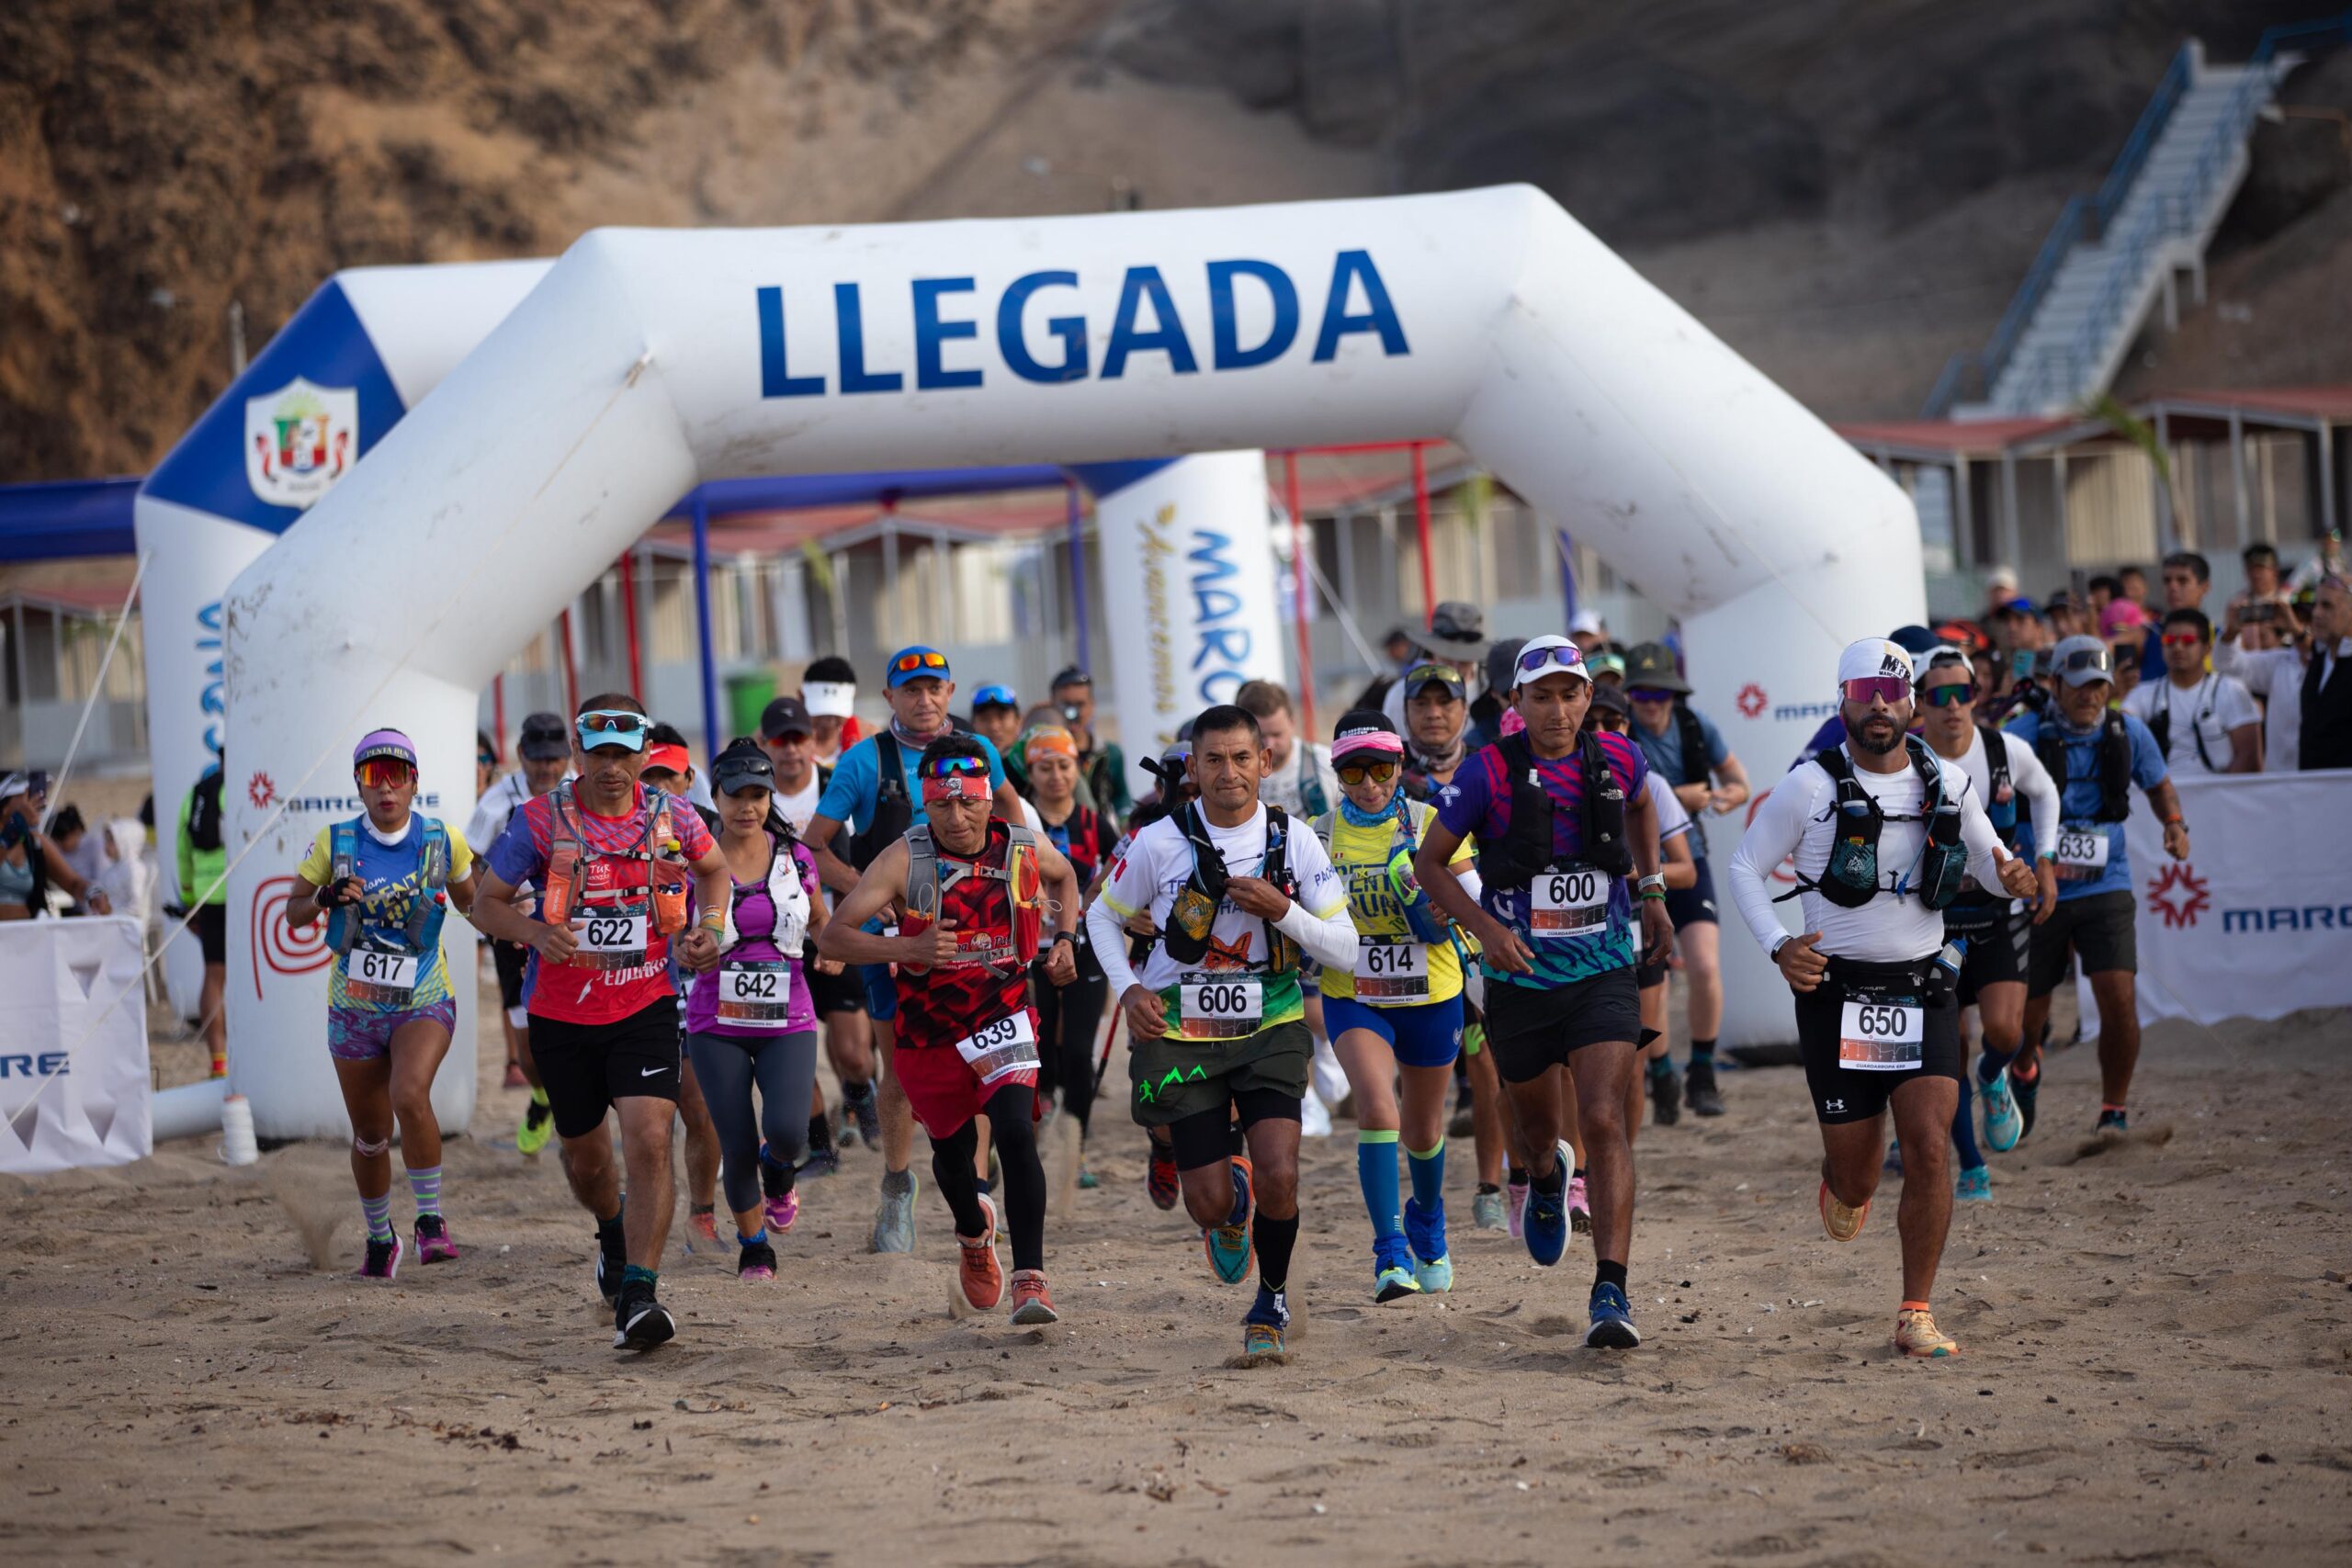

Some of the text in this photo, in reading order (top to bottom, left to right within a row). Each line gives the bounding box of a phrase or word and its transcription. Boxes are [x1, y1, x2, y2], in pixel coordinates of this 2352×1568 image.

[756, 250, 1411, 400] LLEGADA
[2059, 836, 2096, 860] 633
[1549, 873, 1595, 904] 600
[588, 919, 633, 946] 622
[363, 953, 405, 981] 617
[1368, 945, 1414, 973] 614
[735, 972, 776, 998] 642
[1198, 985, 1247, 1013] 606
[972, 1018, 1017, 1050] 639
[1859, 1006, 1906, 1037] 650
